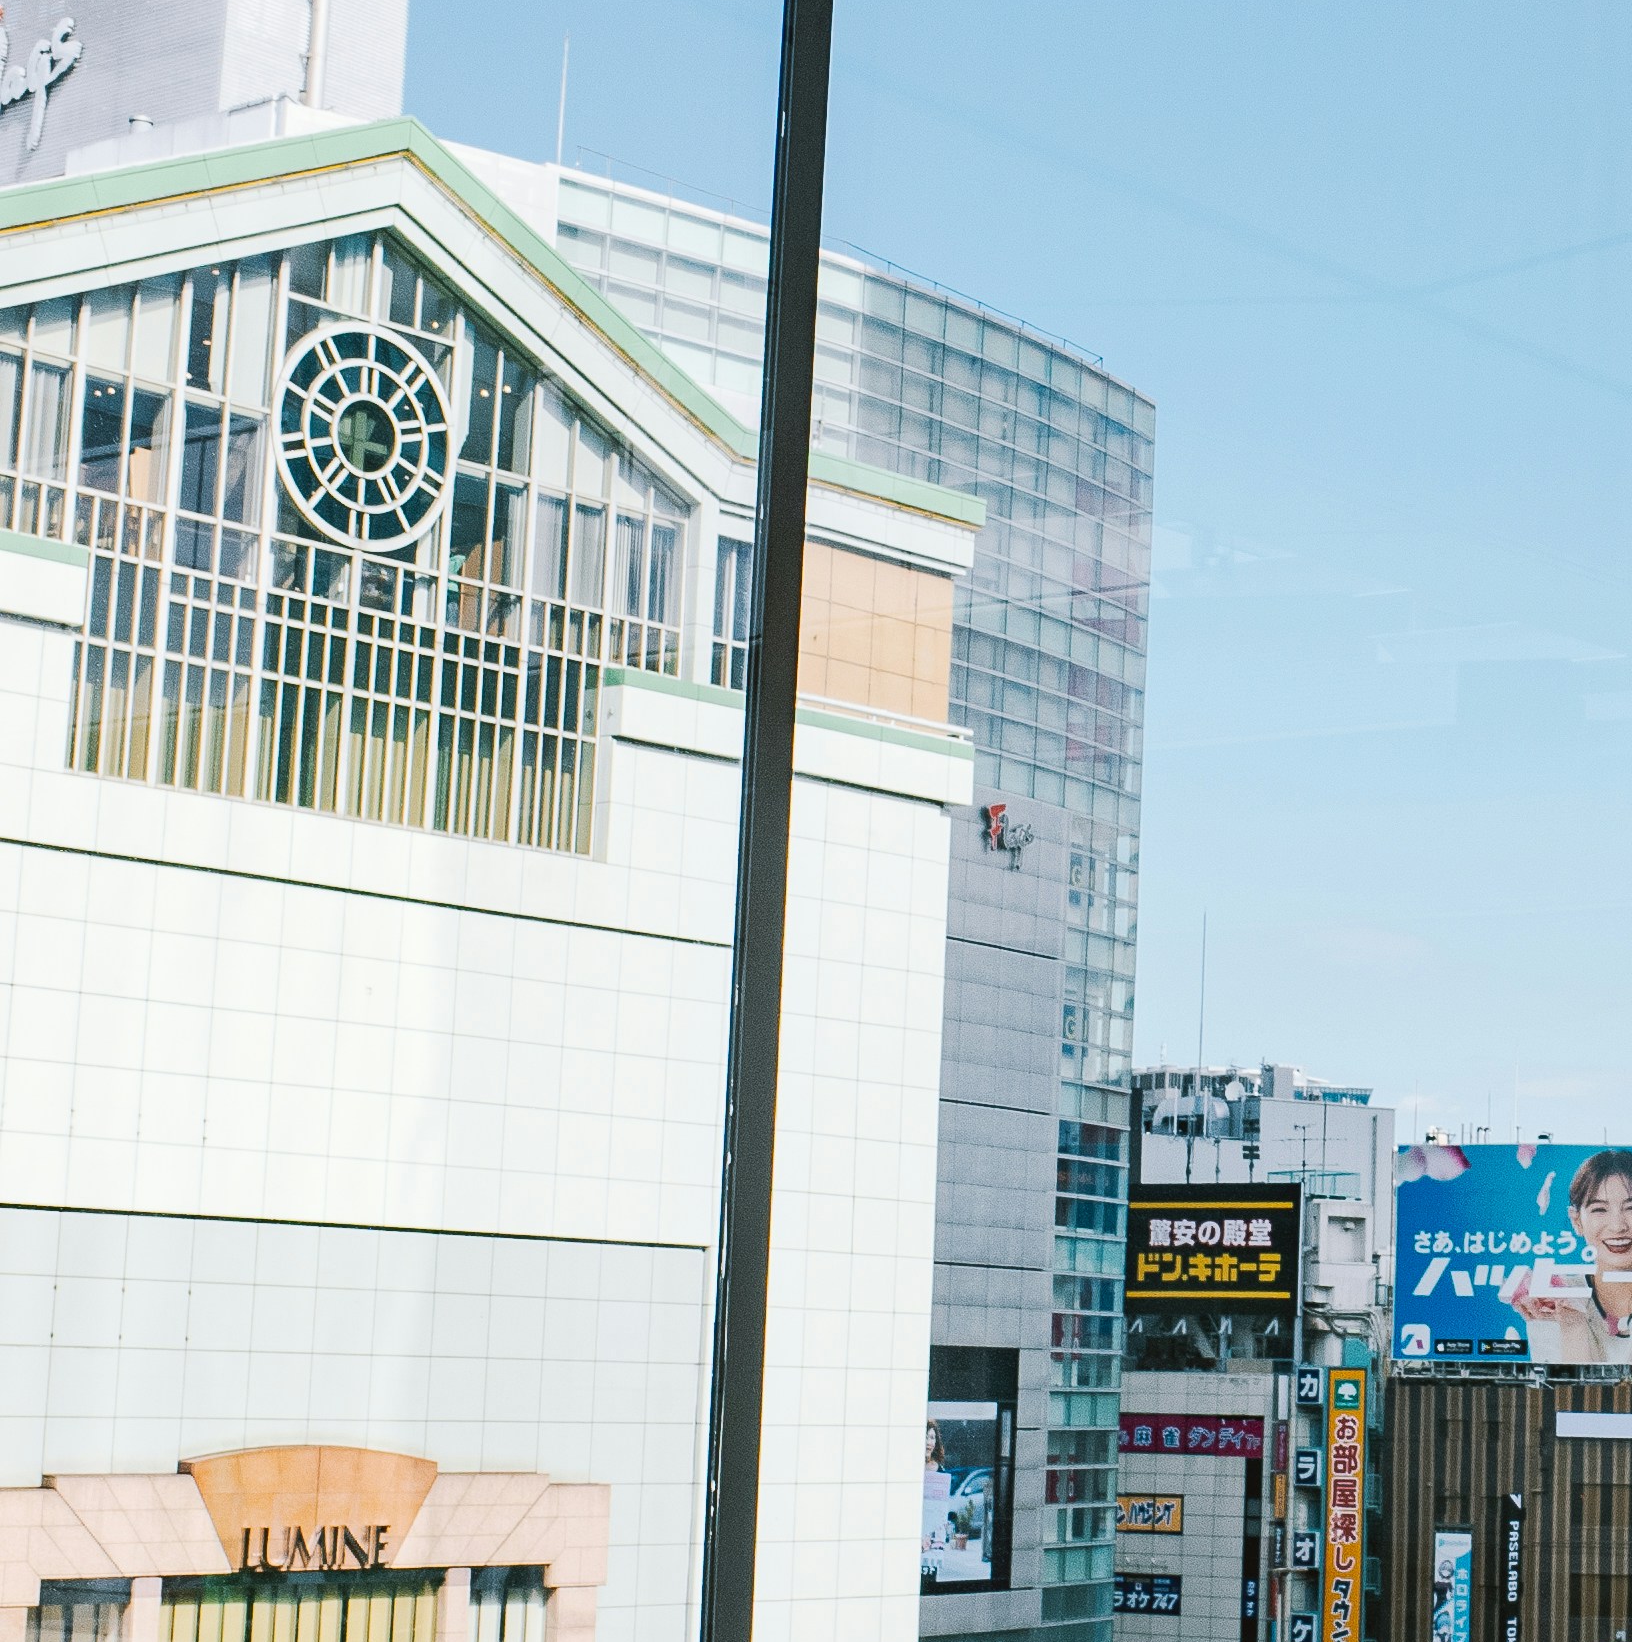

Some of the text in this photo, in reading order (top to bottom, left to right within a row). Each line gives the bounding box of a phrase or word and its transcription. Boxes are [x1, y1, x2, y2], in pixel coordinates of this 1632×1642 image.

[1149, 1218, 1273, 1247] 驚安の殿堂
[1414, 1230, 1598, 1263] さあ、はじめよう。
[1331, 1415, 1361, 1571] お部屋探し
[239, 1524, 391, 1570] LUMINE
[1508, 1520, 1520, 1603] PASELABO
